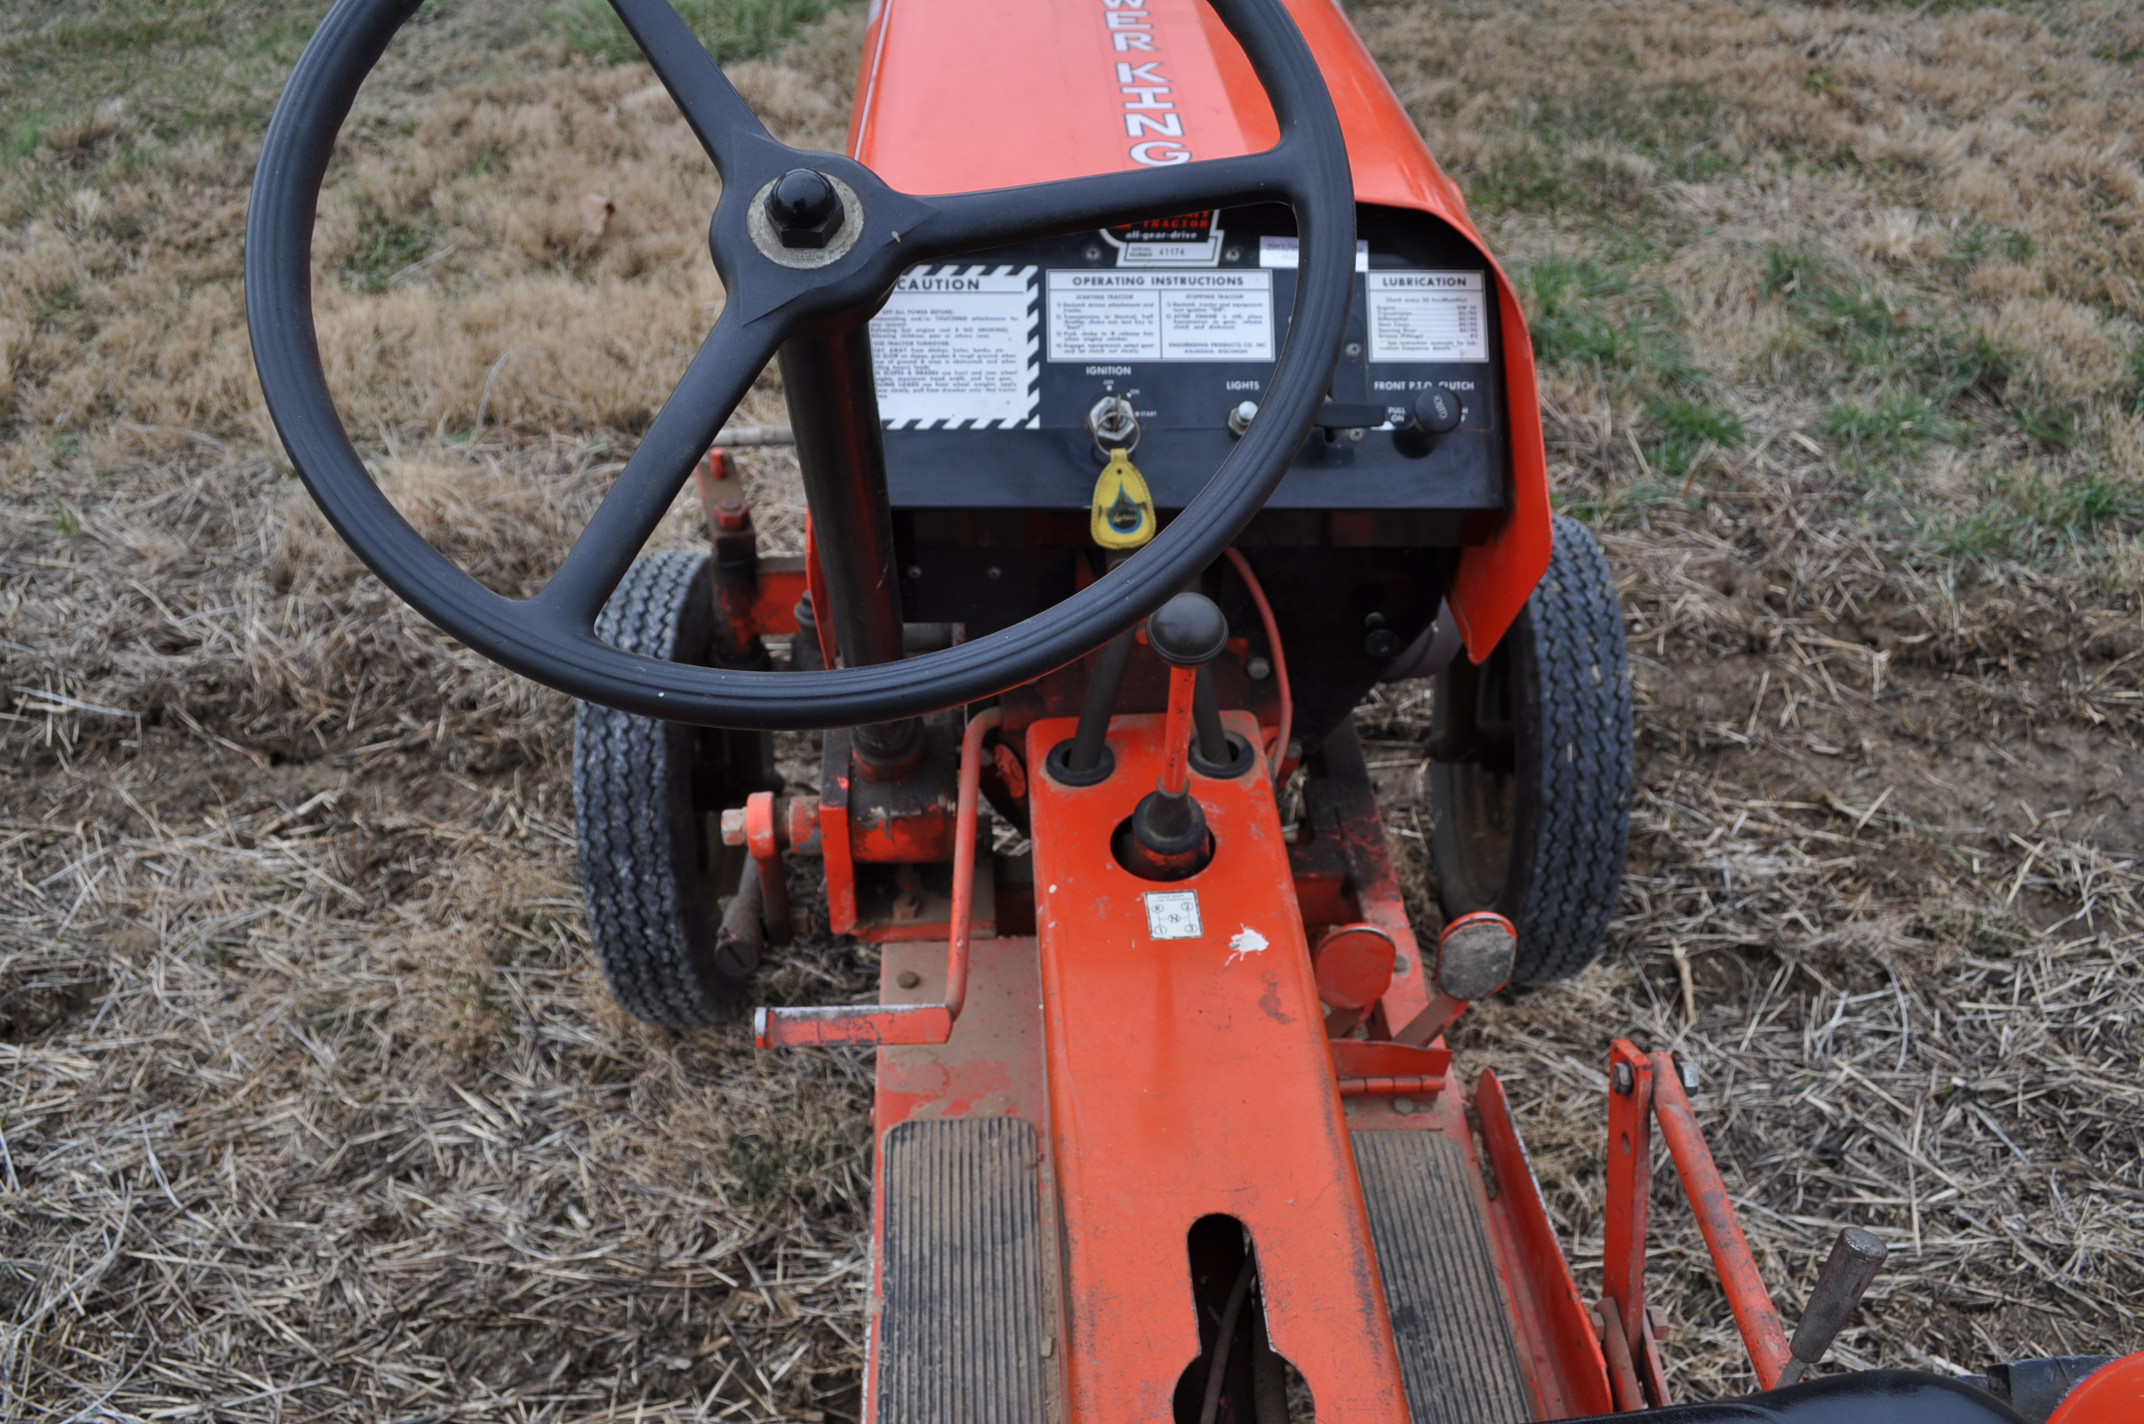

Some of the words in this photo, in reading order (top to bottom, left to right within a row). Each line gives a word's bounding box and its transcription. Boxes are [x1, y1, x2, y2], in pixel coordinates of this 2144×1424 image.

[1115, 62, 1193, 167] KING
[1143, 219, 1209, 229] TRACTOR
[1125, 230, 1197, 240] all-gear-drive
[1158, 248, 1185, 256] 41174
[897, 278, 980, 290] CAUTION
[1072, 276, 1145, 286] OPERATING
[1151, 276, 1244, 286] INSTRUCTIONS
[1382, 277, 1467, 287] LUBRICATION
[1086, 366, 1132, 376] IGNITION
[1226, 381, 1260, 391] LIGHTS
[1374, 381, 1406, 391] FRONT
[1387, 406, 1406, 415] PULL
[1390, 414, 1405, 423] ON
